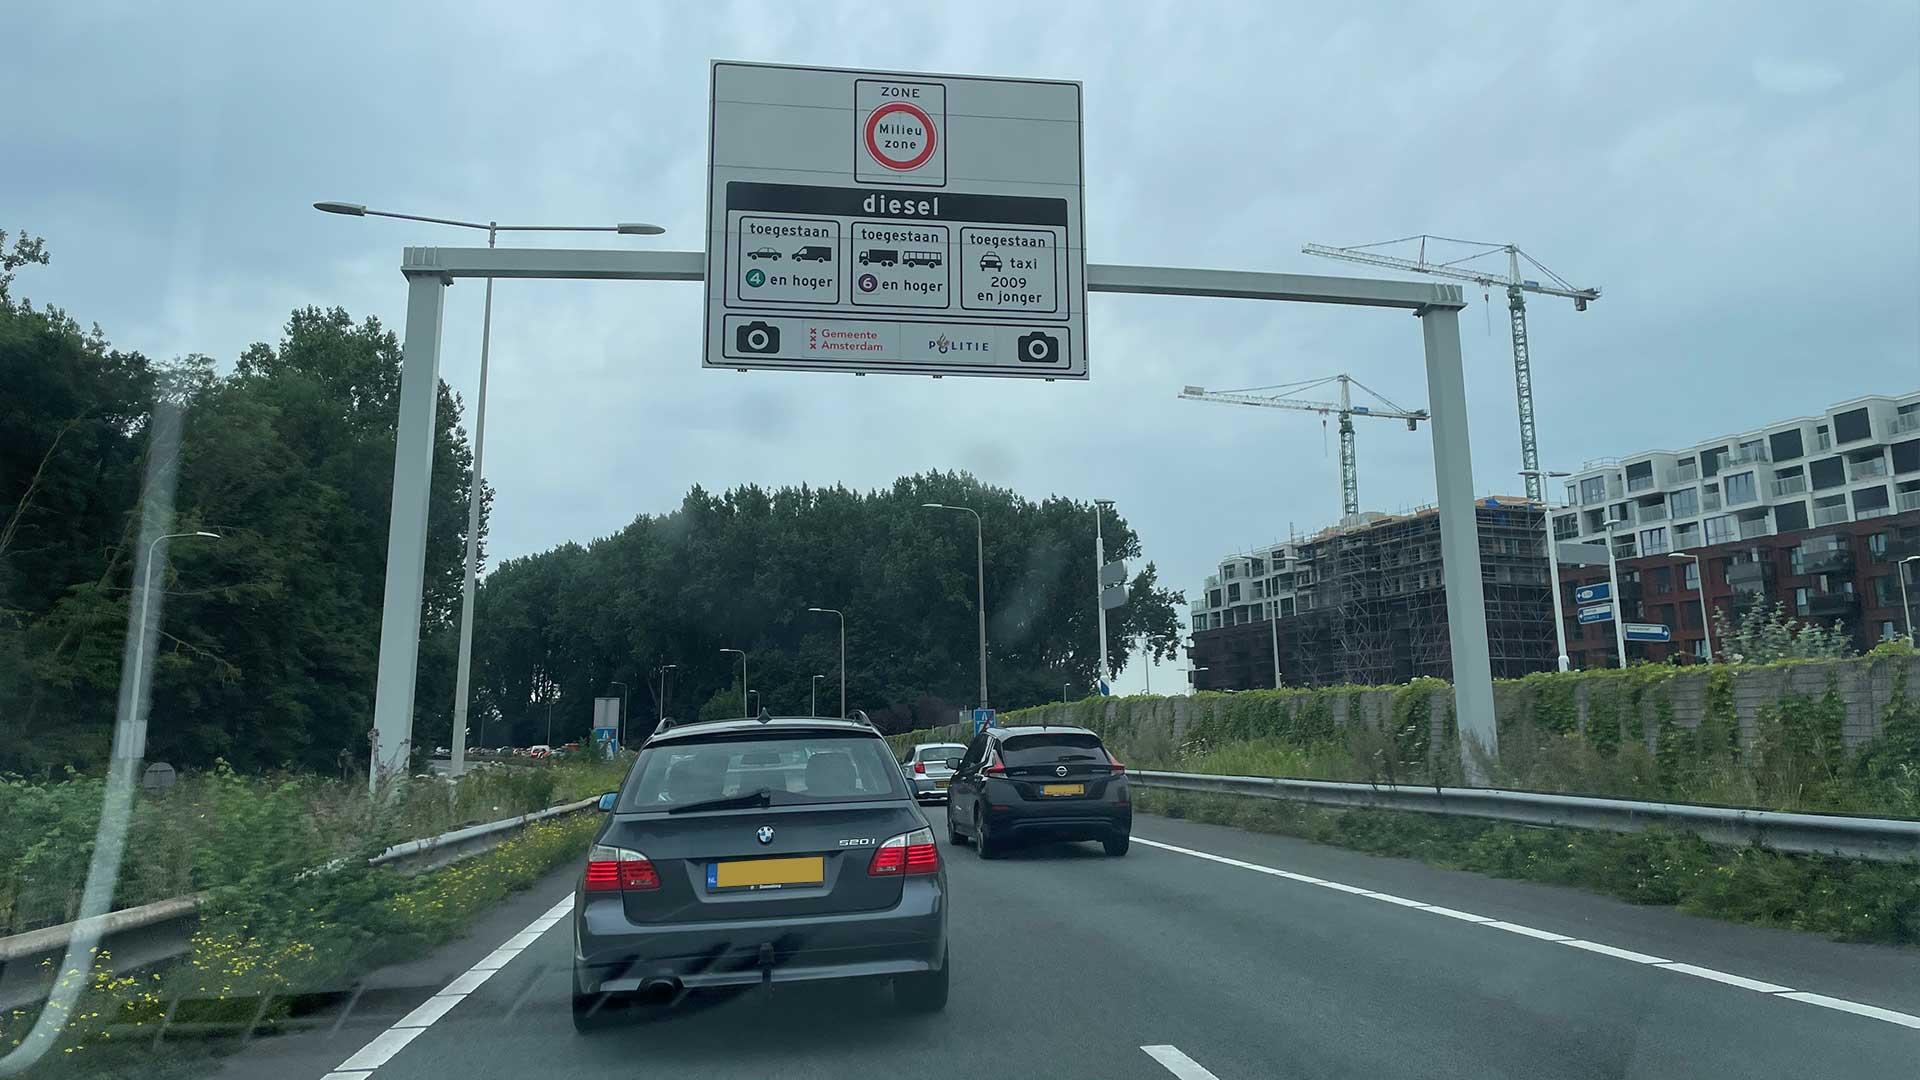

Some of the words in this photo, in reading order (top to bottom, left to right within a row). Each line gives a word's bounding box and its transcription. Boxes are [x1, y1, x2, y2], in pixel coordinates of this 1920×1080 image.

[881, 86, 921, 99] ZONE
[879, 123, 922, 136] Milieu
[884, 138, 917, 150] zone
[862, 193, 940, 217] diesel
[750, 222, 830, 239] toegestaan
[861, 228, 939, 244] toegestaan
[970, 233, 1046, 248] toegestaan
[1009, 256, 1038, 270] taxi
[750, 271, 762, 285] 4
[770, 275, 788, 287] en
[792, 274, 833, 291] hoger
[861, 276, 874, 291] 6
[881, 280, 899, 291] en
[903, 278, 944, 296] hoger
[990, 275, 1027, 289] 2009
[977, 290, 994, 302] en
[997, 290, 1042, 306] jonger
[821, 328, 878, 341] Gemeente
[821, 340, 883, 352] Amsterdam
[928, 338, 989, 354] POLITIE
